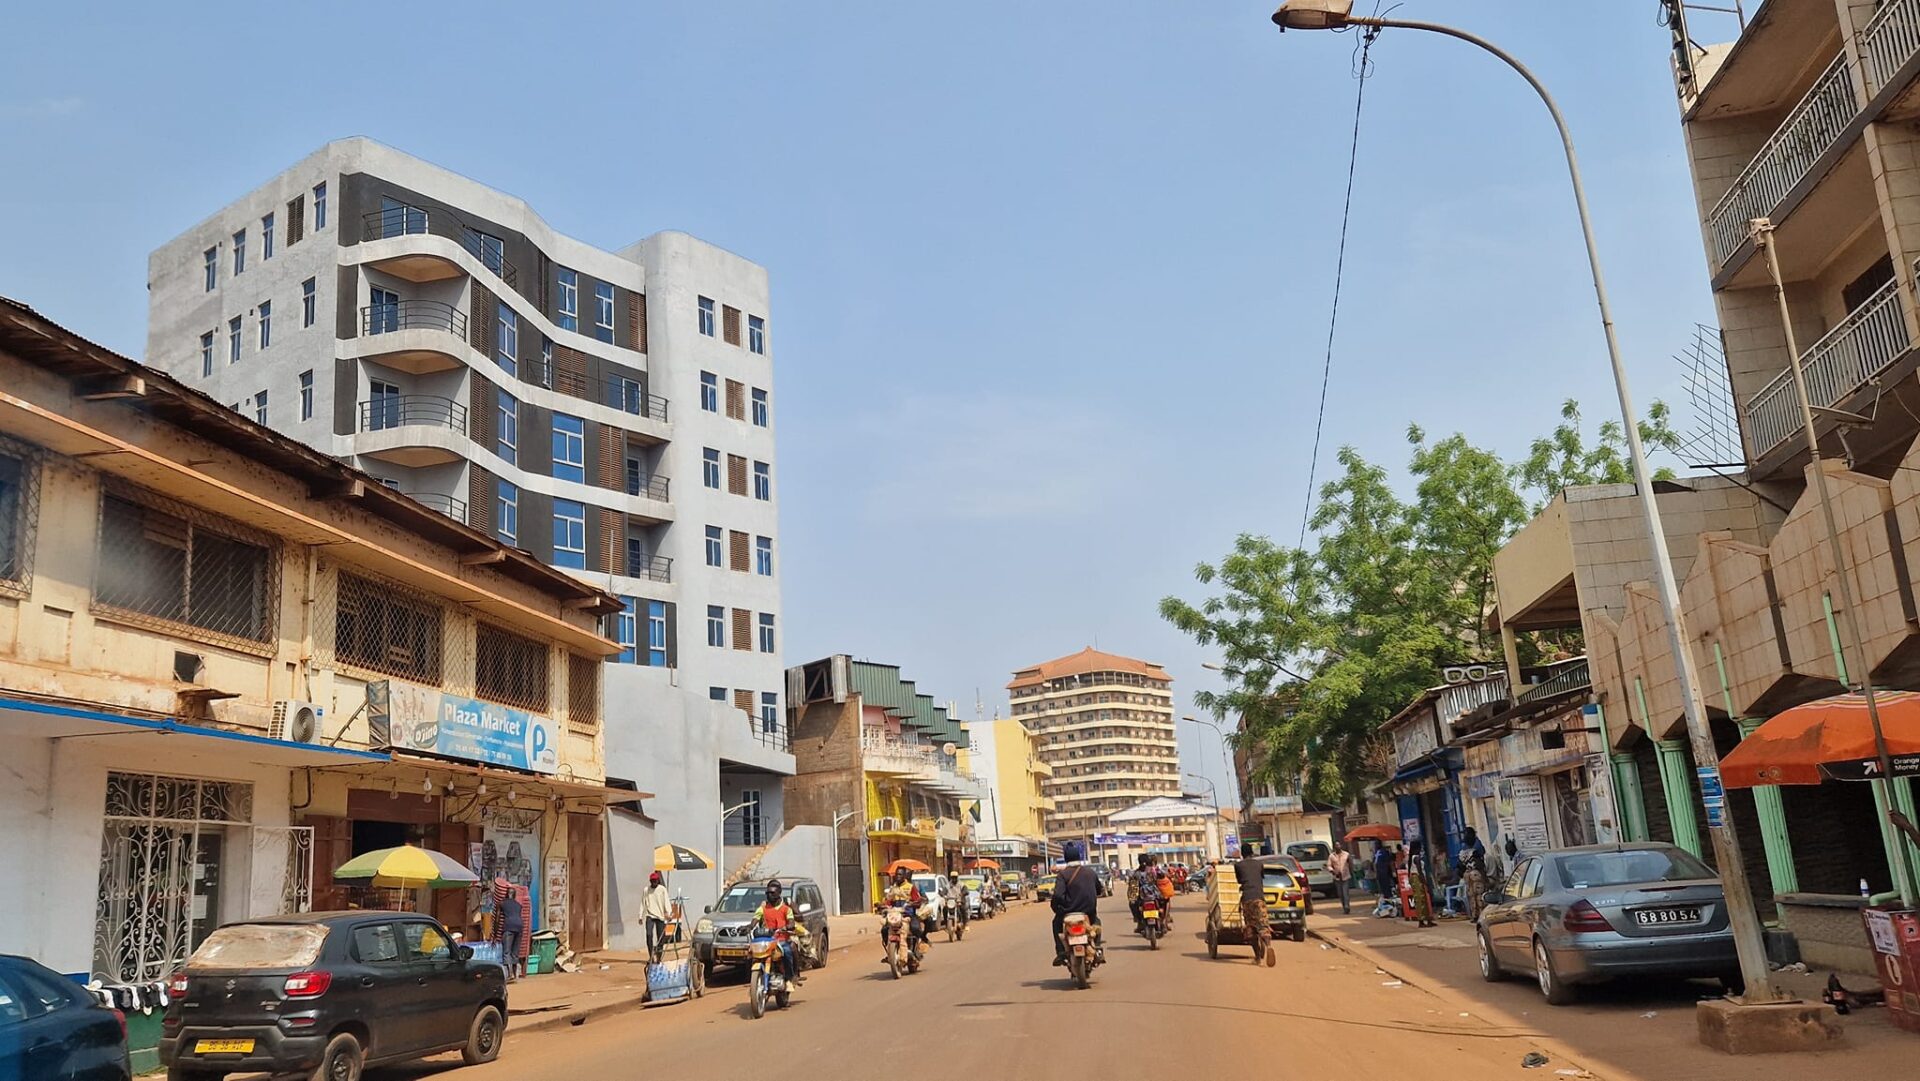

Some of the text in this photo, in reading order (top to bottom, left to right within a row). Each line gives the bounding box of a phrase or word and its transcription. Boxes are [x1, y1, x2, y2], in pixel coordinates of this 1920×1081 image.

[444, 702, 521, 736] Plaza Market
[1893, 758, 1920, 766] Orange
